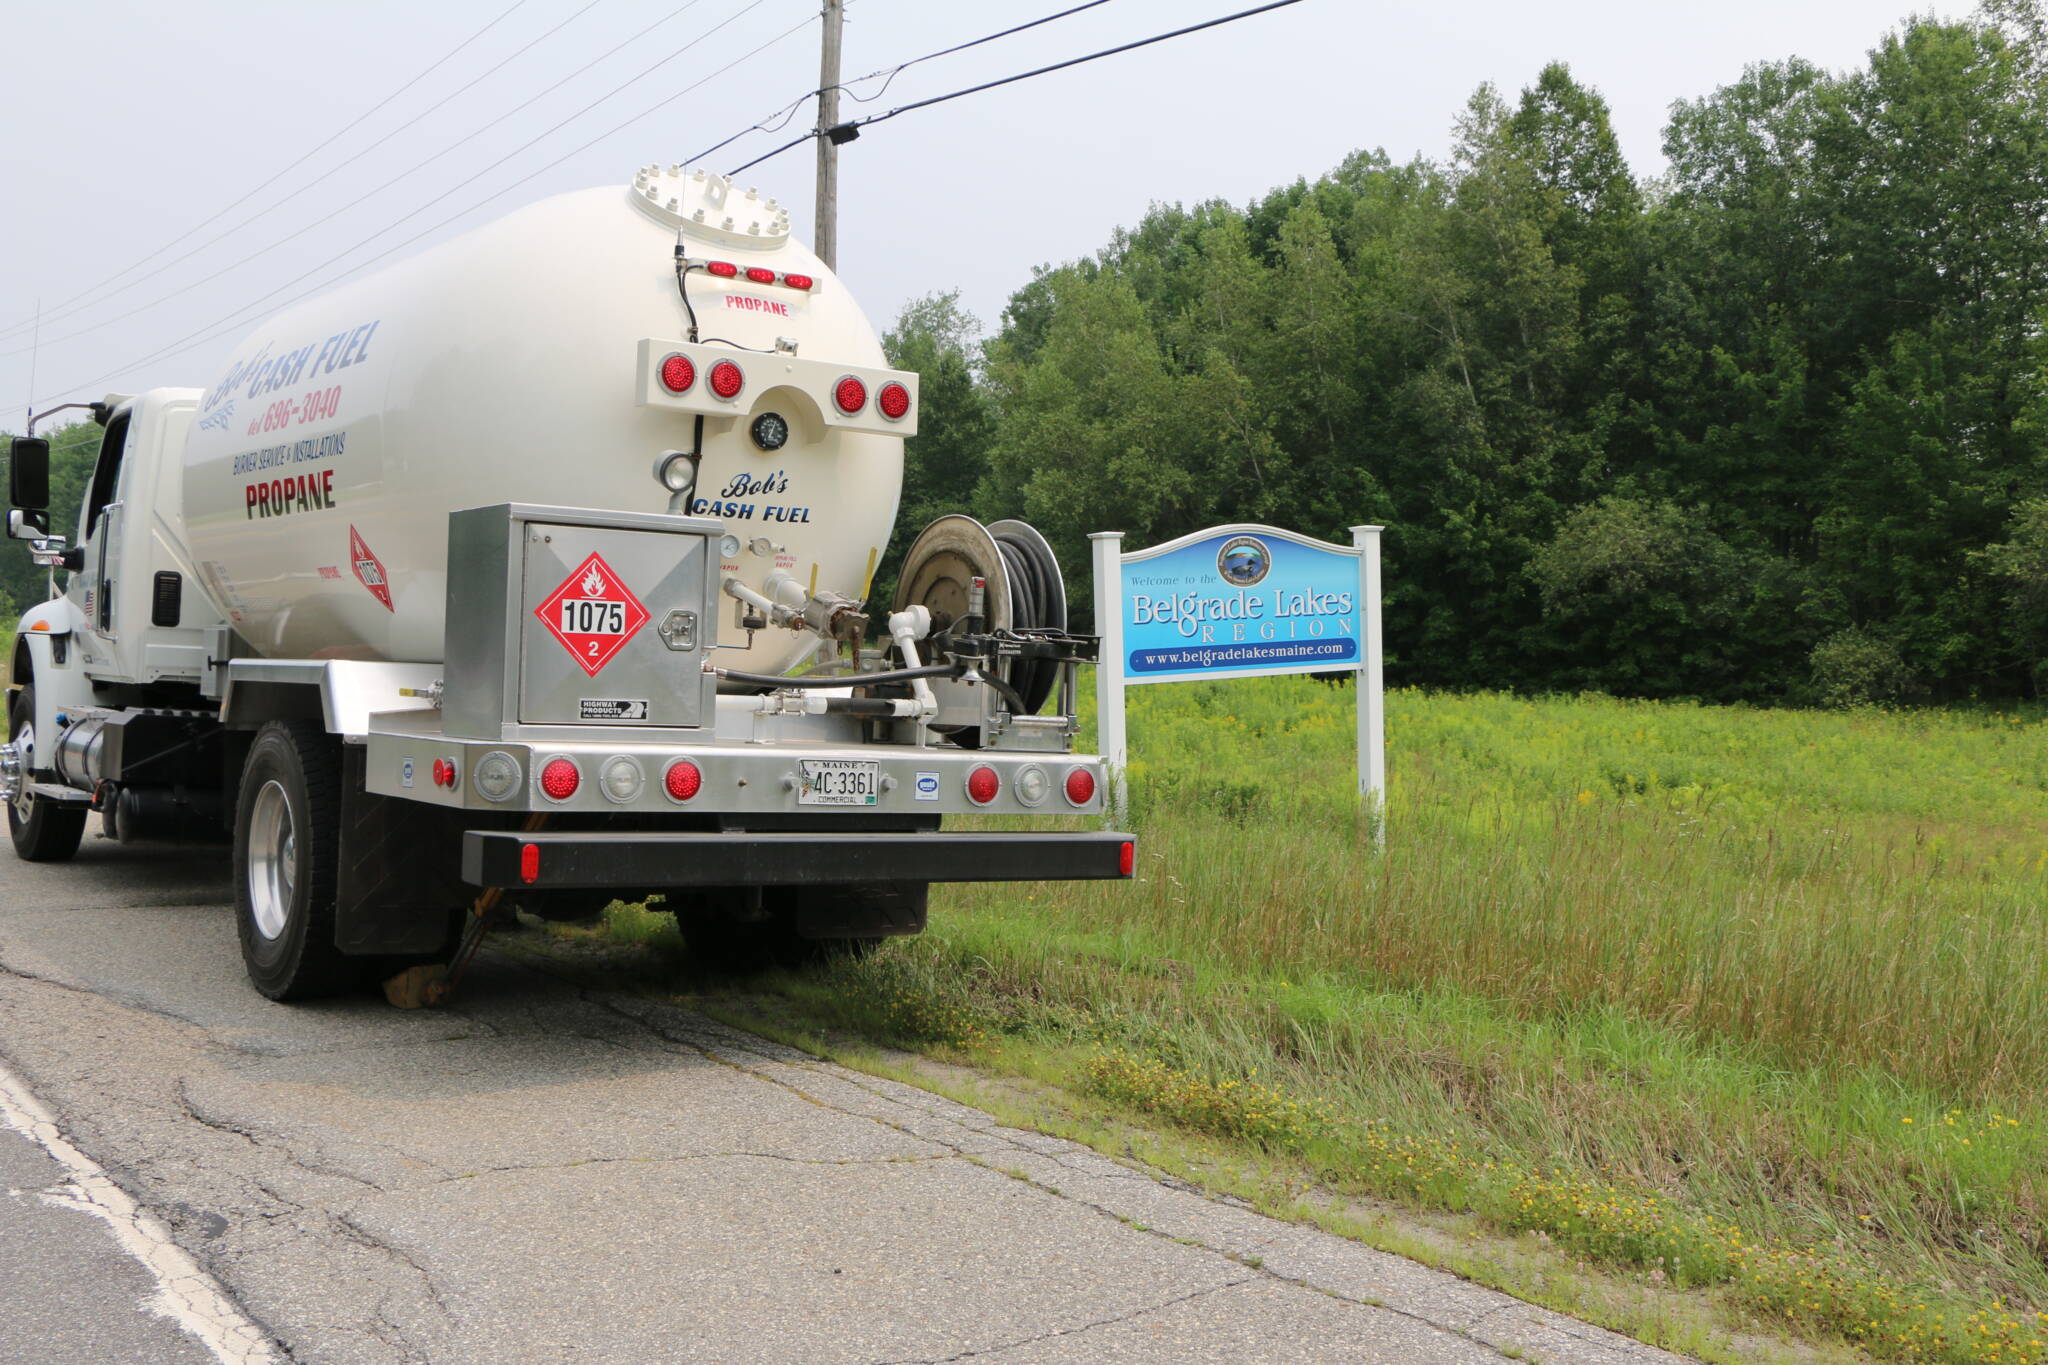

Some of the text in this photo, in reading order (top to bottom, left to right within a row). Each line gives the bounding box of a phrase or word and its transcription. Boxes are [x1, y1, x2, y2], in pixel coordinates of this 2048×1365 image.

[726, 295, 789, 317] PROPANE
[248, 343, 317, 400] CASH
[309, 320, 380, 379] FUEL
[263, 385, 342, 432] 696-3040
[233, 452, 258, 475] BURNER
[258, 445, 287, 470] SERVICE
[292, 432, 346, 463] INSTALLATIONS
[246, 469, 336, 520] PROPANE
[721, 469, 789, 498] Bob's
[692, 498, 810, 523] CASH FUEL
[1132, 574, 1217, 586] Welcome to the
[564, 601, 623, 633] 1075
[1132, 586, 1352, 637] Belgrade Lakes
[1201, 618, 1351, 643] REGION
[588, 641, 599, 656] 2
[1145, 644, 1343, 666] www.belgradelakesmaine.com
[818, 795, 857, 804] COMMERCIAL
